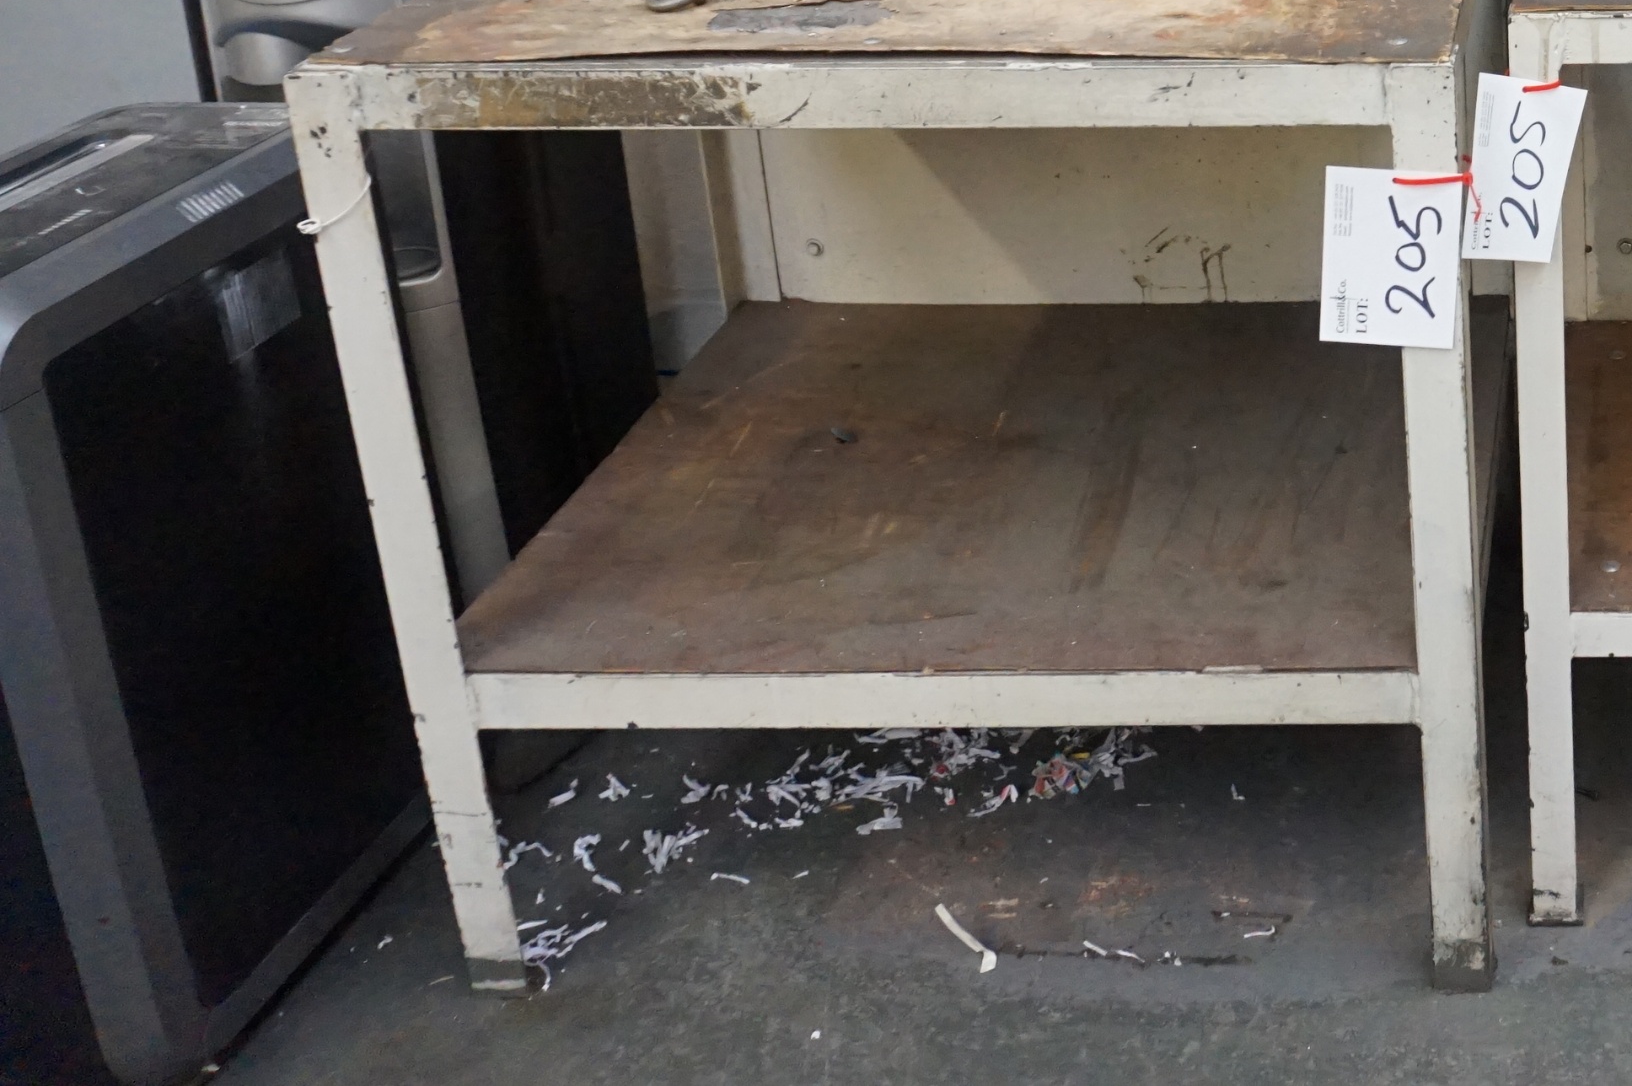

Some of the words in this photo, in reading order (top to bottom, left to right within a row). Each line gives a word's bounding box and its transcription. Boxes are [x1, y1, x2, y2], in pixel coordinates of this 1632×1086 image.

[1500, 100, 1547, 239] 205
[1385, 195, 1442, 319] 205
[1482, 212, 1494, 250] LOT:
[1355, 297, 1369, 335] LOT:
